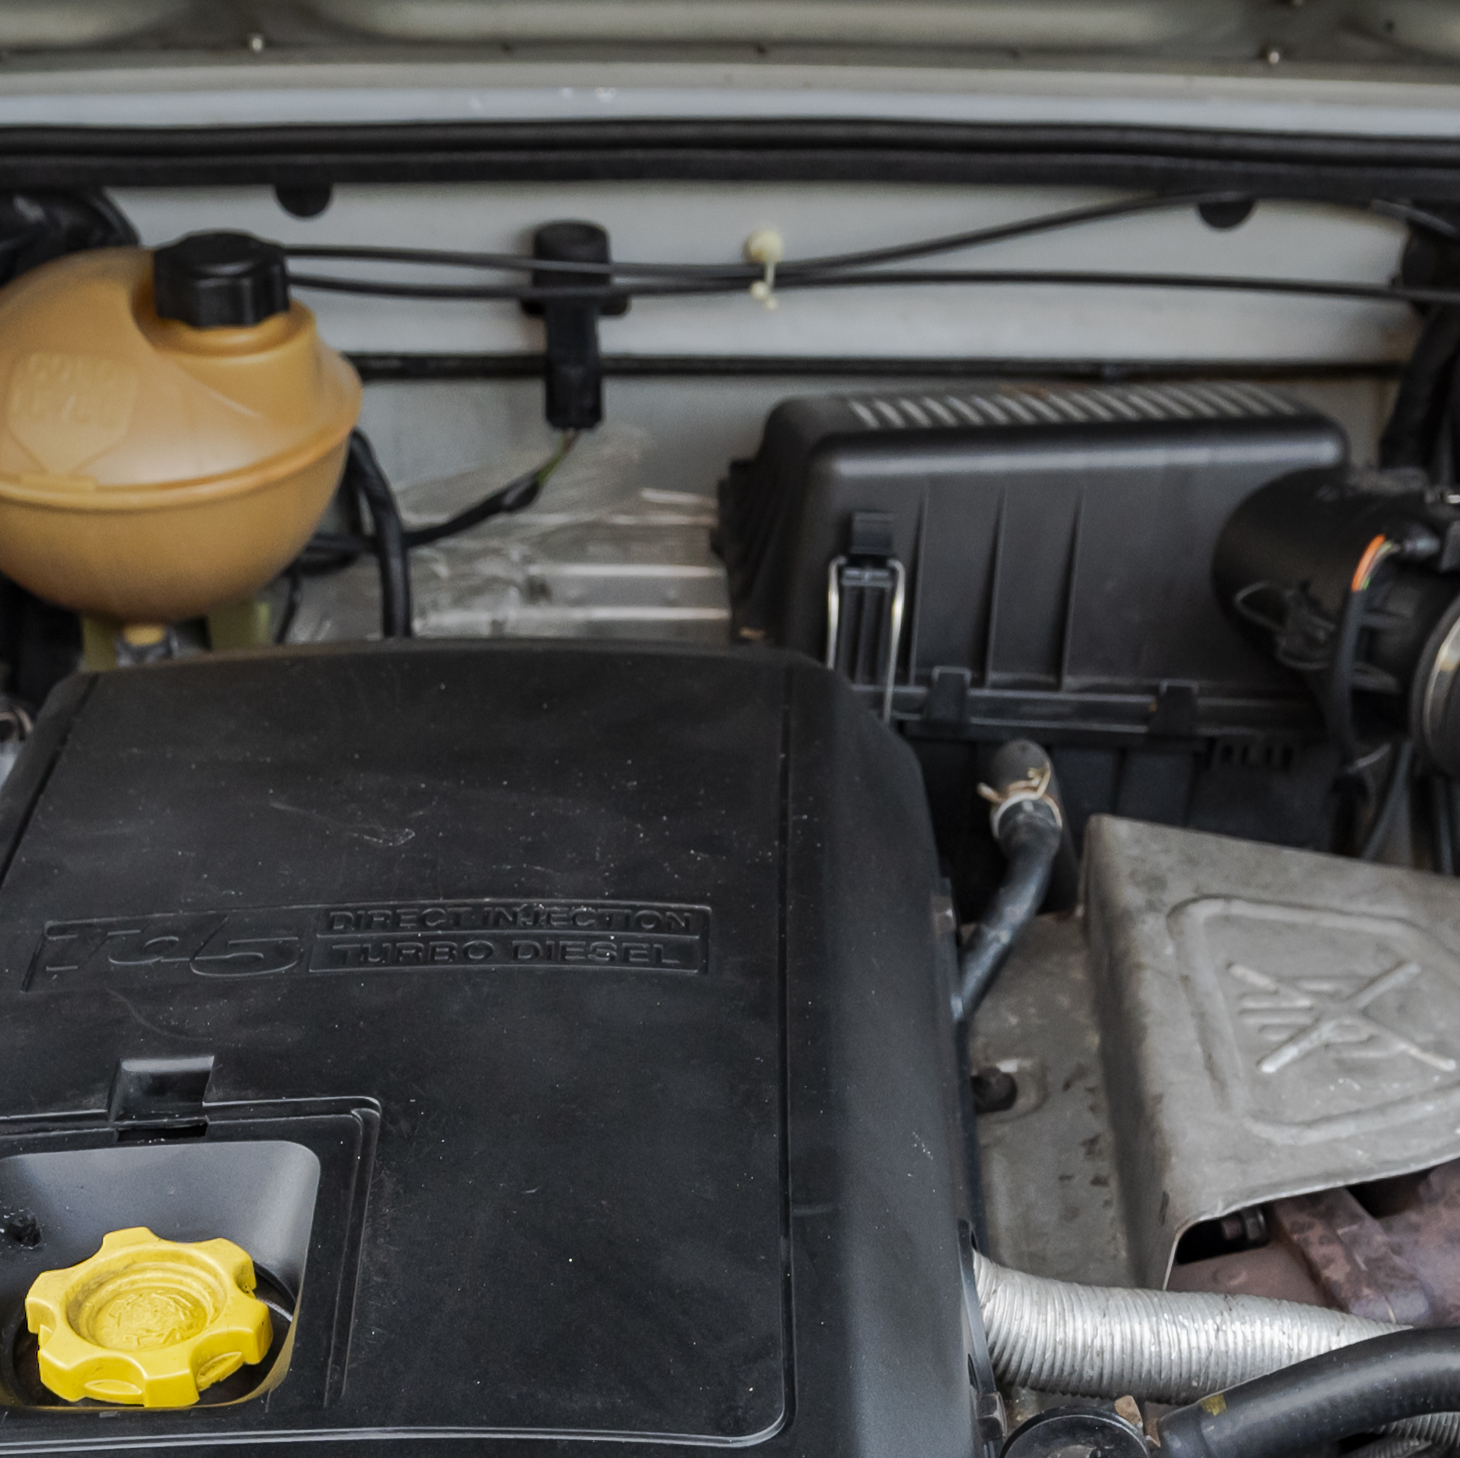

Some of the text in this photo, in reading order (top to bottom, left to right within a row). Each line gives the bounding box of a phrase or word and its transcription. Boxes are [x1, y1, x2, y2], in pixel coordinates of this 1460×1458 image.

[329, 904, 693, 932] DIRECT INJECTION
[331, 939, 680, 964] TURBO DIESEL
